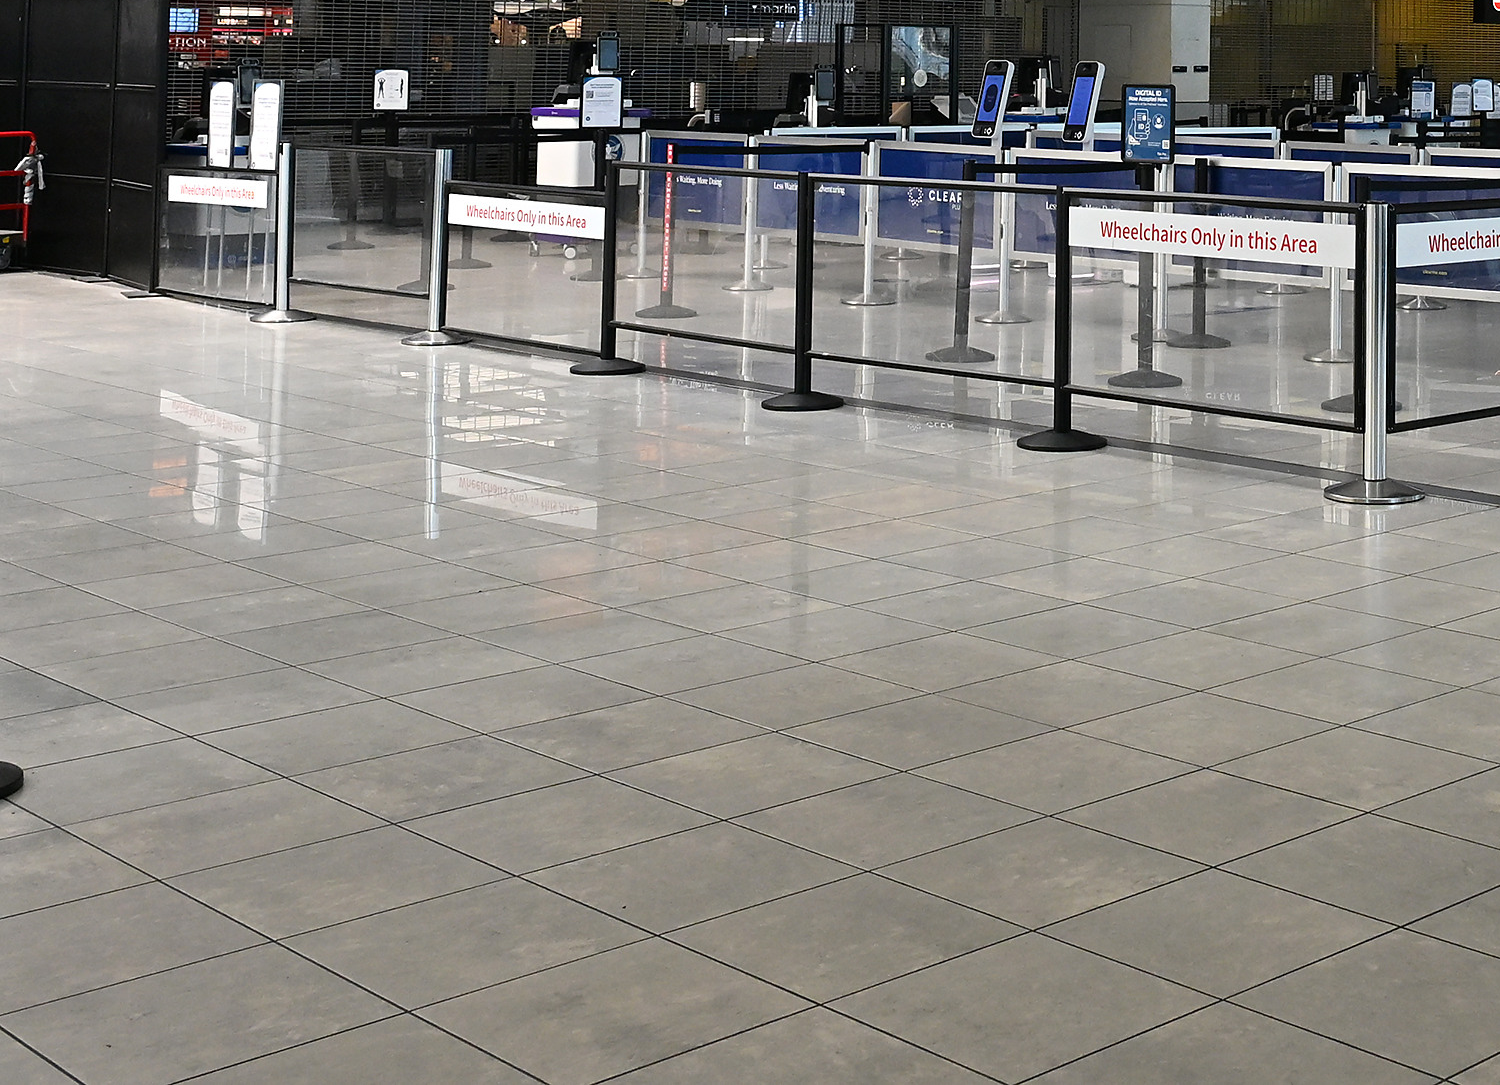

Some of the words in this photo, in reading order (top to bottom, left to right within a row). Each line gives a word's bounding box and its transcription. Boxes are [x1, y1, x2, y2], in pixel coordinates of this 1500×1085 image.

[697, 176, 708, 185] More
[709, 177, 722, 187] Doing
[773, 182, 783, 190] Less
[181, 184, 211, 196] Wheelchairs
[212, 186, 224, 200] Only
[225, 187, 230, 197] in
[231, 187, 241, 199] this
[242, 189, 255, 199] Area
[466, 204, 516, 222] Wheelchairs
[517, 210, 536, 227] Only
[538, 211, 546, 224] in
[549, 212, 564, 226] this
[566, 215, 587, 229] Area
[1100, 221, 1187, 244] Wheelchairs
[1191, 227, 1226, 252] Only
[1229, 229, 1244, 249] in
[1247, 231, 1277, 251] this
[1280, 234, 1318, 254] Area
